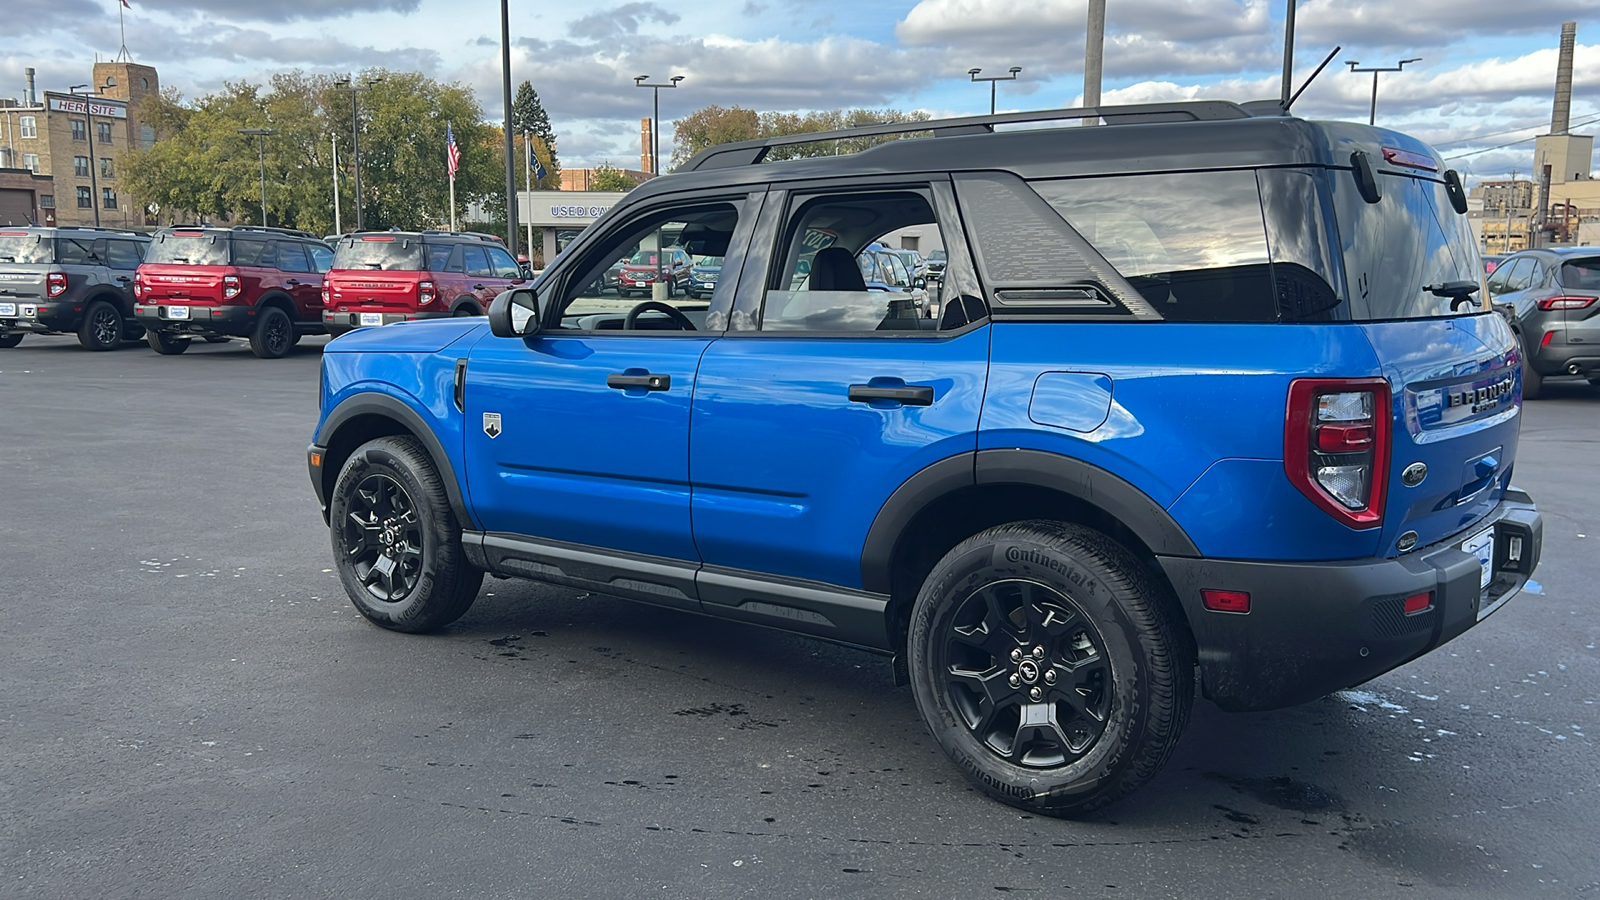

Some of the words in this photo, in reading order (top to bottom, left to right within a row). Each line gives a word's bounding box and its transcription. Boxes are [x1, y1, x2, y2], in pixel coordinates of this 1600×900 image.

[551, 206, 585, 217] USED
[589, 206, 612, 217] CA
[1449, 378, 1512, 408] BRONCO
[1472, 400, 1498, 413] SPORT
[1005, 546, 1087, 587] Continental
